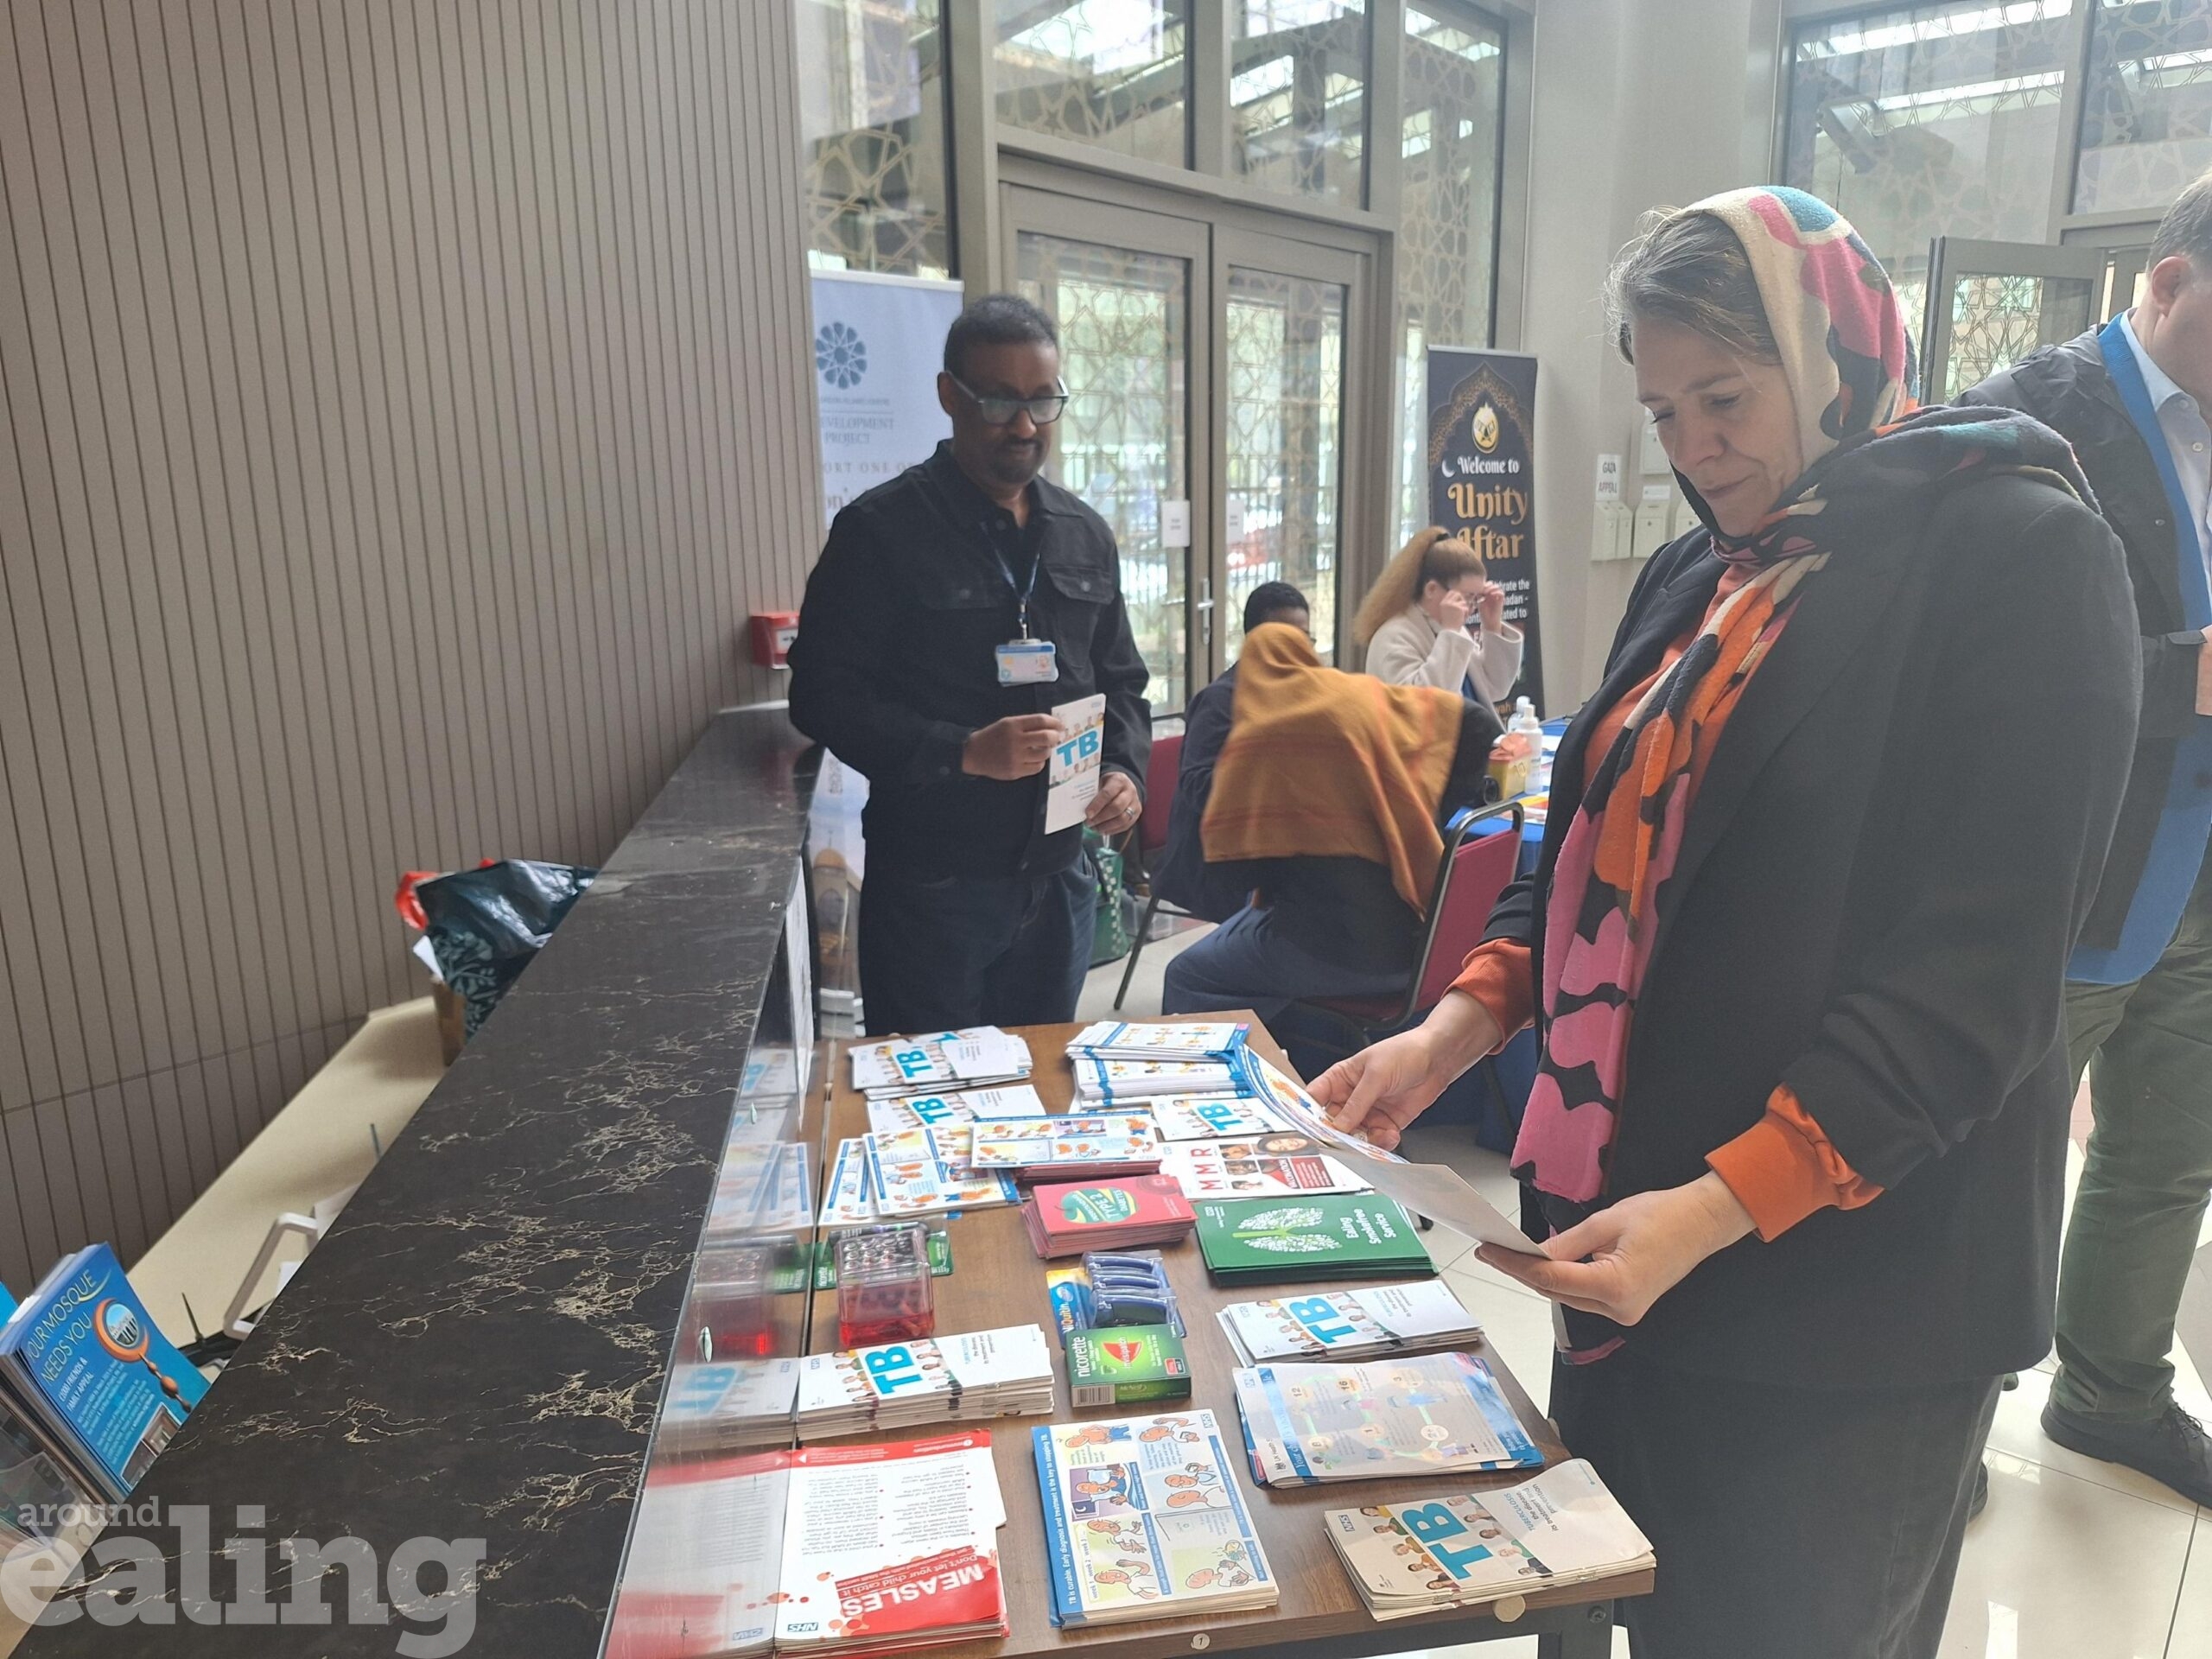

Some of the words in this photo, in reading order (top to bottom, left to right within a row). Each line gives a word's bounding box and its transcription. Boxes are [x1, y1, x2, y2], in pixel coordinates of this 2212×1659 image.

[1457, 456, 1505, 474] Welcome
[1508, 458, 1520, 474] to
[1447, 482, 1528, 525] Unity
[1518, 579, 1529, 589] the
[1519, 608, 1527, 619] to
[1056, 729, 1099, 767] TB
[896, 1050, 934, 1078] TB
[912, 1097, 954, 1125] TB
[1197, 1103, 1243, 1131] TB
[1096, 1199, 1120, 1219] TYPE
[1340, 1217, 1359, 1239] Ealing
[1354, 1209, 1382, 1244] Smokefree
[1375, 1212, 1397, 1238] Service
[41, 1269, 97, 1333] MOSQUE
[1289, 1297, 1357, 1344] TB
[41, 1340, 73, 1386] NEEDS
[64, 1312, 92, 1345] YOU
[1071, 1336, 1090, 1377] nicorette
[865, 1345, 923, 1395] TB
[1292, 1387, 1302, 1397] 12
[1339, 1381, 1350, 1390] 16
[1338, 1515, 1355, 1532] NHS
[1504, 1493, 1535, 1531] TUBERCULOSIS
[1530, 1510, 1539, 1520] the
[1401, 1503, 1494, 1580] TB
[933, 1561, 948, 1571] let
[950, 1554, 978, 1567] Don't
[882, 1574, 906, 1586] child
[910, 1567, 933, 1579] your
[842, 1563, 984, 1617] MEASLES
[853, 1580, 880, 1593] catch
[787, 1622, 818, 1632] NHS
